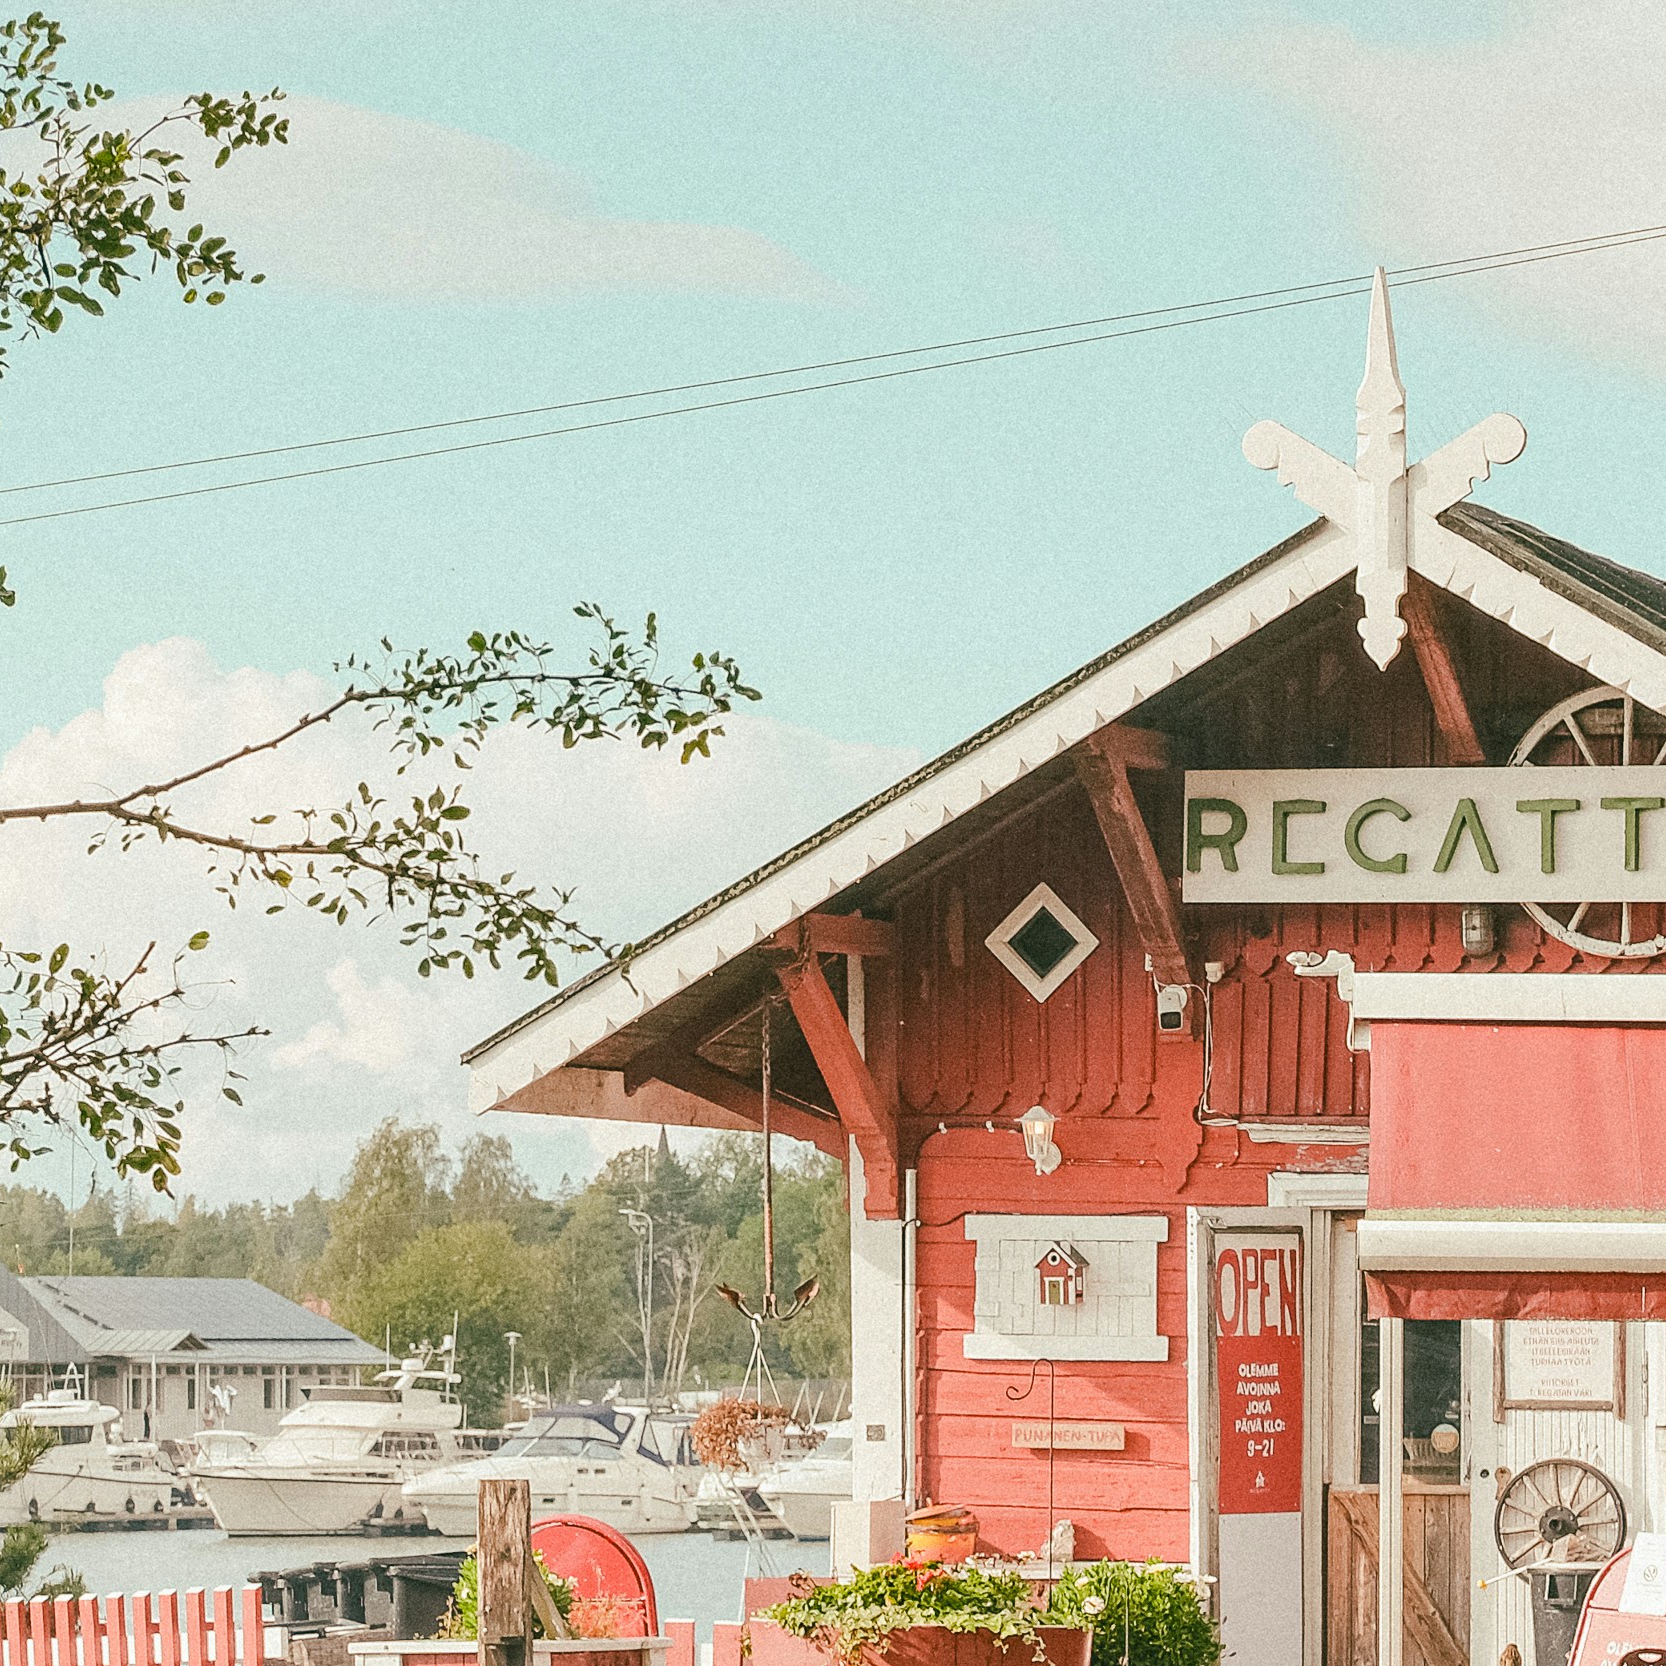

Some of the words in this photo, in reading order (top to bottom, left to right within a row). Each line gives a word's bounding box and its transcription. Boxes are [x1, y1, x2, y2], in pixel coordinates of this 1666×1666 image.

[1216, 1248, 1298, 1337] OPEN
[1238, 1362, 1280, 1378] OLEMME
[1236, 1380, 1282, 1397] AVOINNA
[1245, 1399, 1272, 1416] JOKA
[1234, 1417, 1263, 1435] PÄIVÄ
[1246, 1438, 1275, 1458] 9-21
